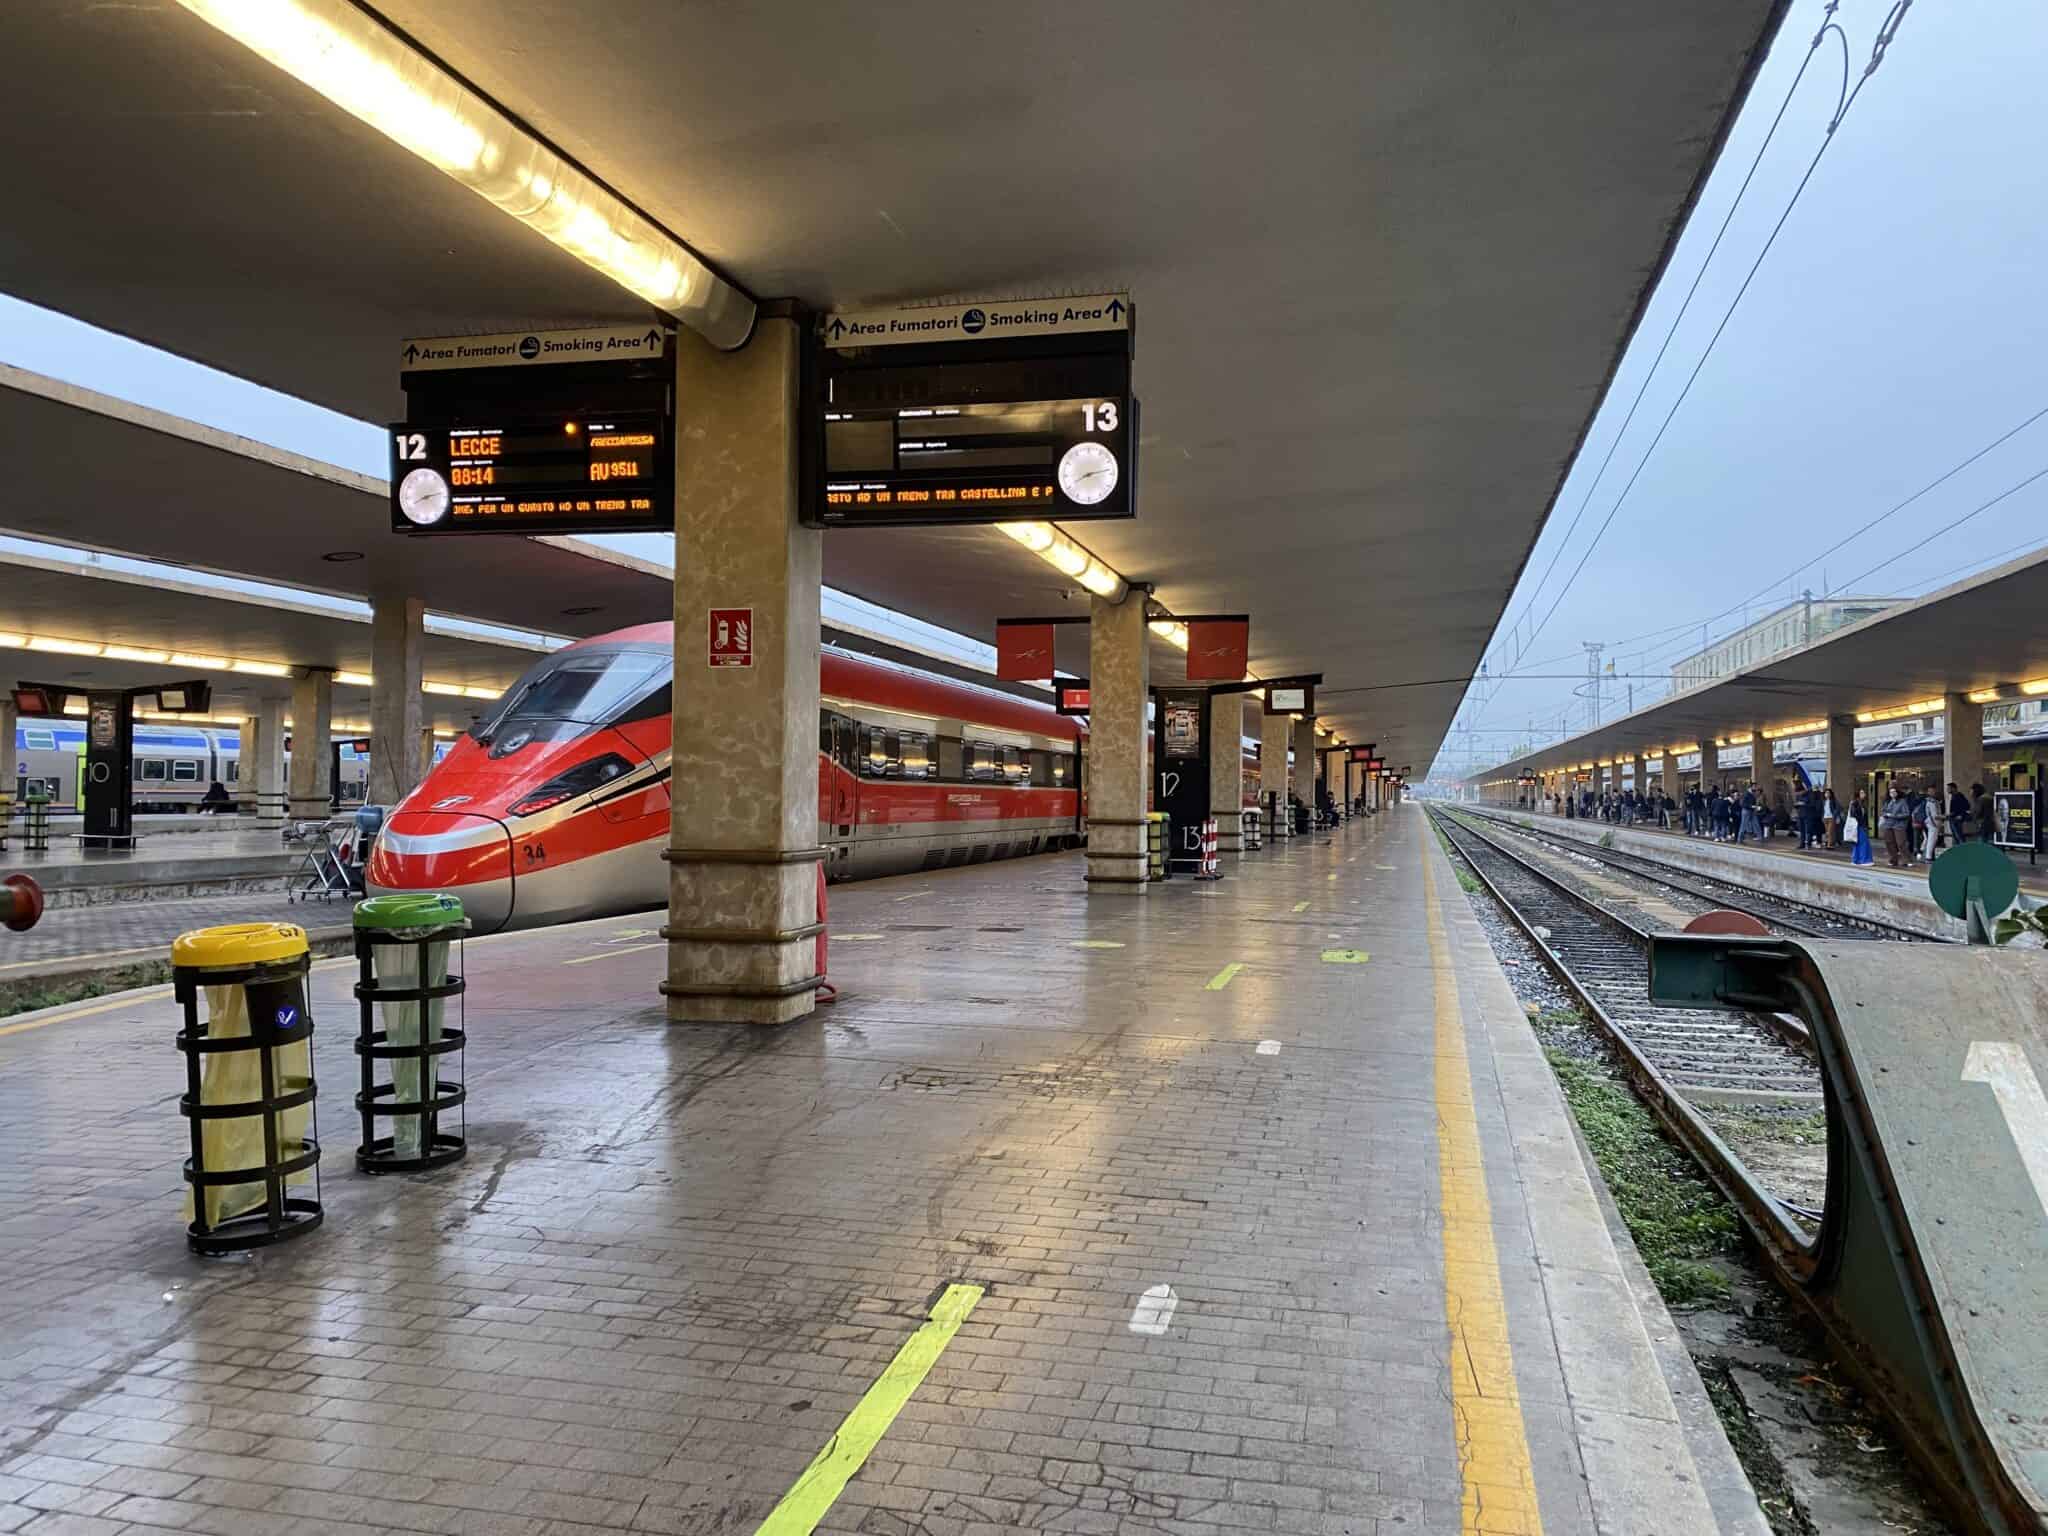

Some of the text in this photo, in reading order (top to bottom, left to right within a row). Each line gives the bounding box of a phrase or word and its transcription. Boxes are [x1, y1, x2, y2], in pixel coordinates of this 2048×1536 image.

[850, 315, 957, 335] Area Fumatori
[990, 308, 1102, 325] Smoking Area
[422, 342, 516, 360] Area Fumatori
[543, 337, 641, 352] Smoking Area
[1082, 402, 1119, 432] 13
[396, 433, 427, 460] 12
[450, 437, 502, 456] LECCE
[451, 466, 494, 486] 08:14
[590, 462, 609, 481] AV
[935, 489, 956, 500] TRA
[961, 487, 1027, 499] CASTELLINA
[1031, 486, 1040, 497] E
[1045, 486, 1054, 497] P
[18, 762, 27, 774] 2
[88, 761, 110, 783] 10
[1160, 771, 1180, 797] 12
[1182, 825, 1201, 850] 13
[523, 842, 546, 864] 34
